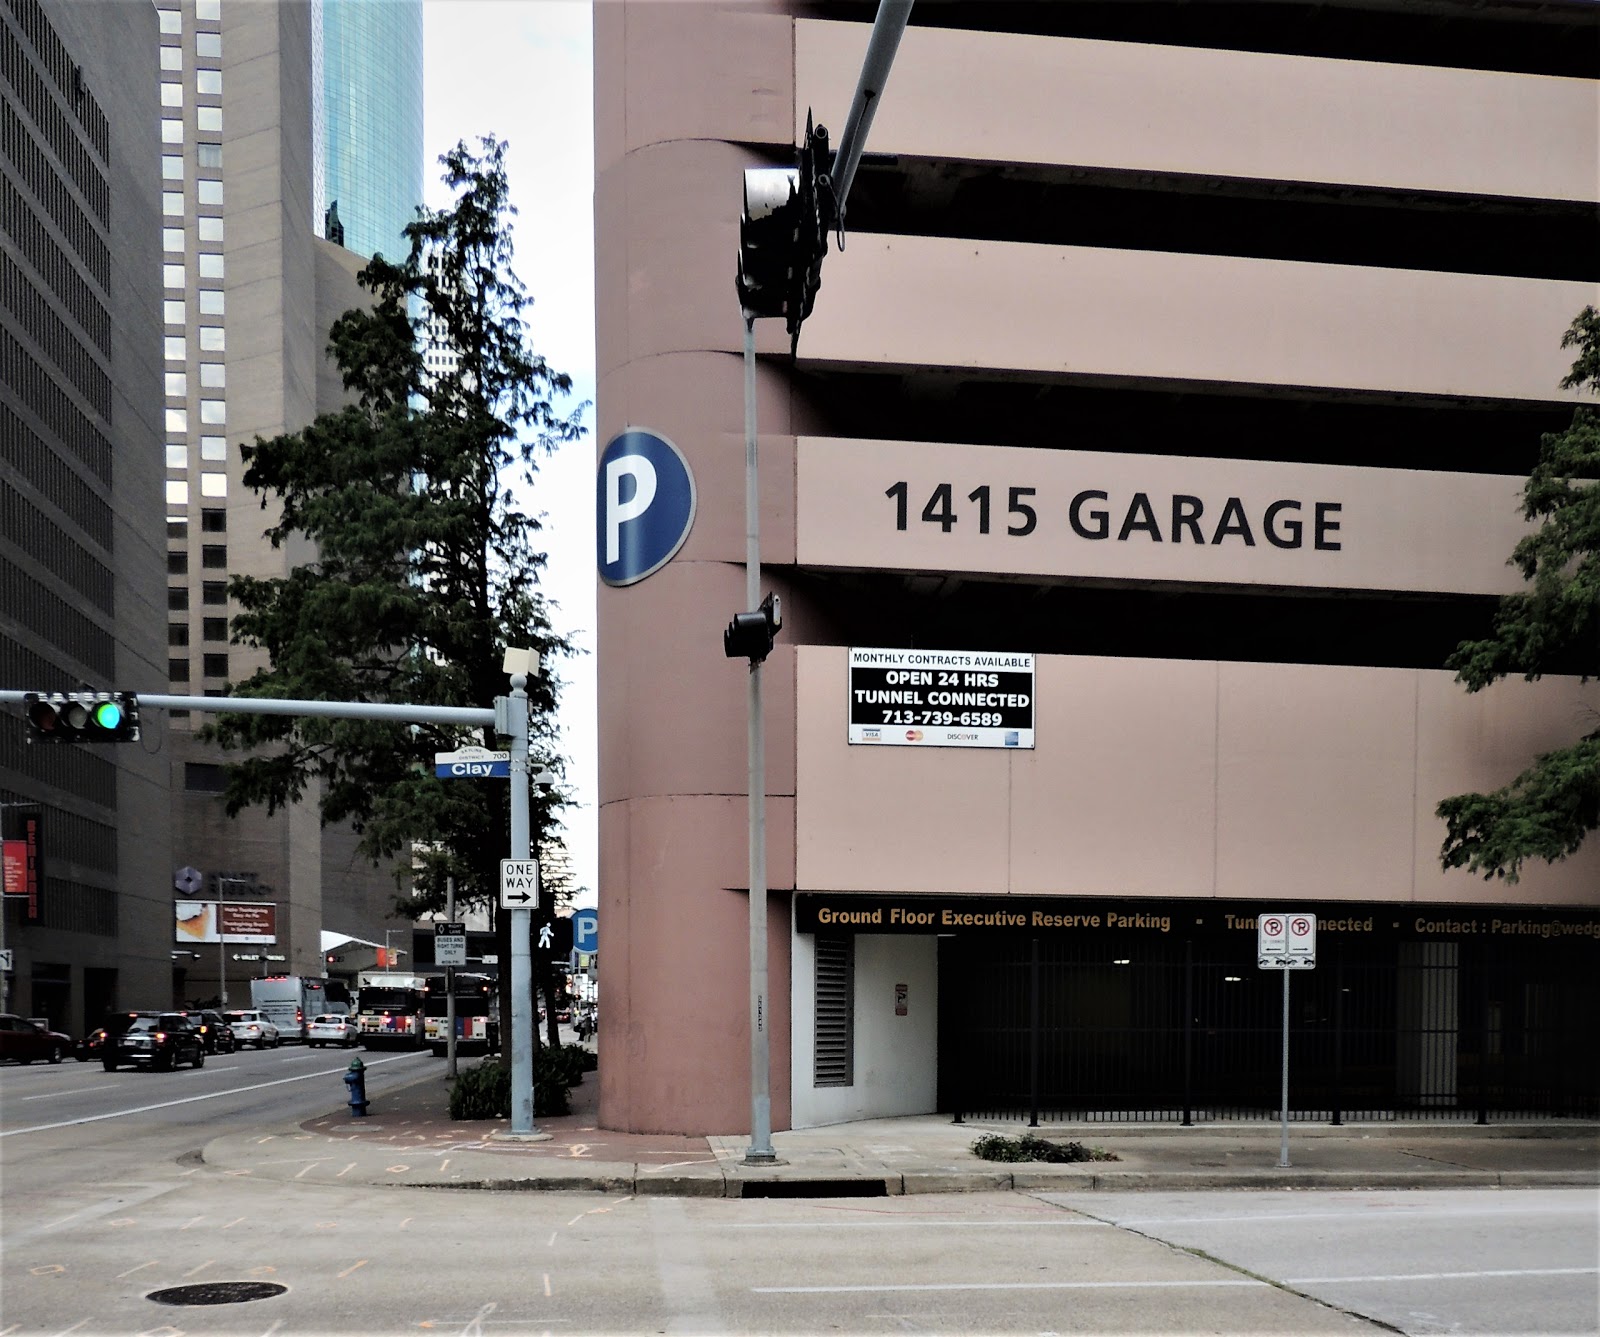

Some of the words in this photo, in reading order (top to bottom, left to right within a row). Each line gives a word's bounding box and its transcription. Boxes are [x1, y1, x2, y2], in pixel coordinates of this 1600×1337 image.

[606, 455, 657, 565] P
[884, 481, 1037, 537] 1415
[1069, 490, 1342, 552] GARAGE
[853, 653, 904, 664] MONTHLY
[908, 655, 971, 666] CONTRACTS
[974, 657, 1031, 668] AVAILABLE
[886, 670, 932, 685] OPEN
[938, 672, 959, 686] 24
[964, 673, 999, 688] HRS
[855, 690, 923, 705] TUNNEL
[927, 692, 1030, 708] CONNECTED
[882, 710, 1002, 726] 713-739-6589
[947, 733, 979, 741] DISCOVER
[451, 763, 493, 777] Clay
[506, 864, 533, 875] ONE
[506, 878, 533, 888] WAY
[818, 907, 882, 925] Ground
[890, 908, 934, 925] Floor
[941, 909, 1026, 927] Executive
[1032, 911, 1100, 928] Reserve
[1107, 912, 1171, 932] Parking
[1415, 918, 1478, 933] Contact
[578, 917, 597, 943] P
